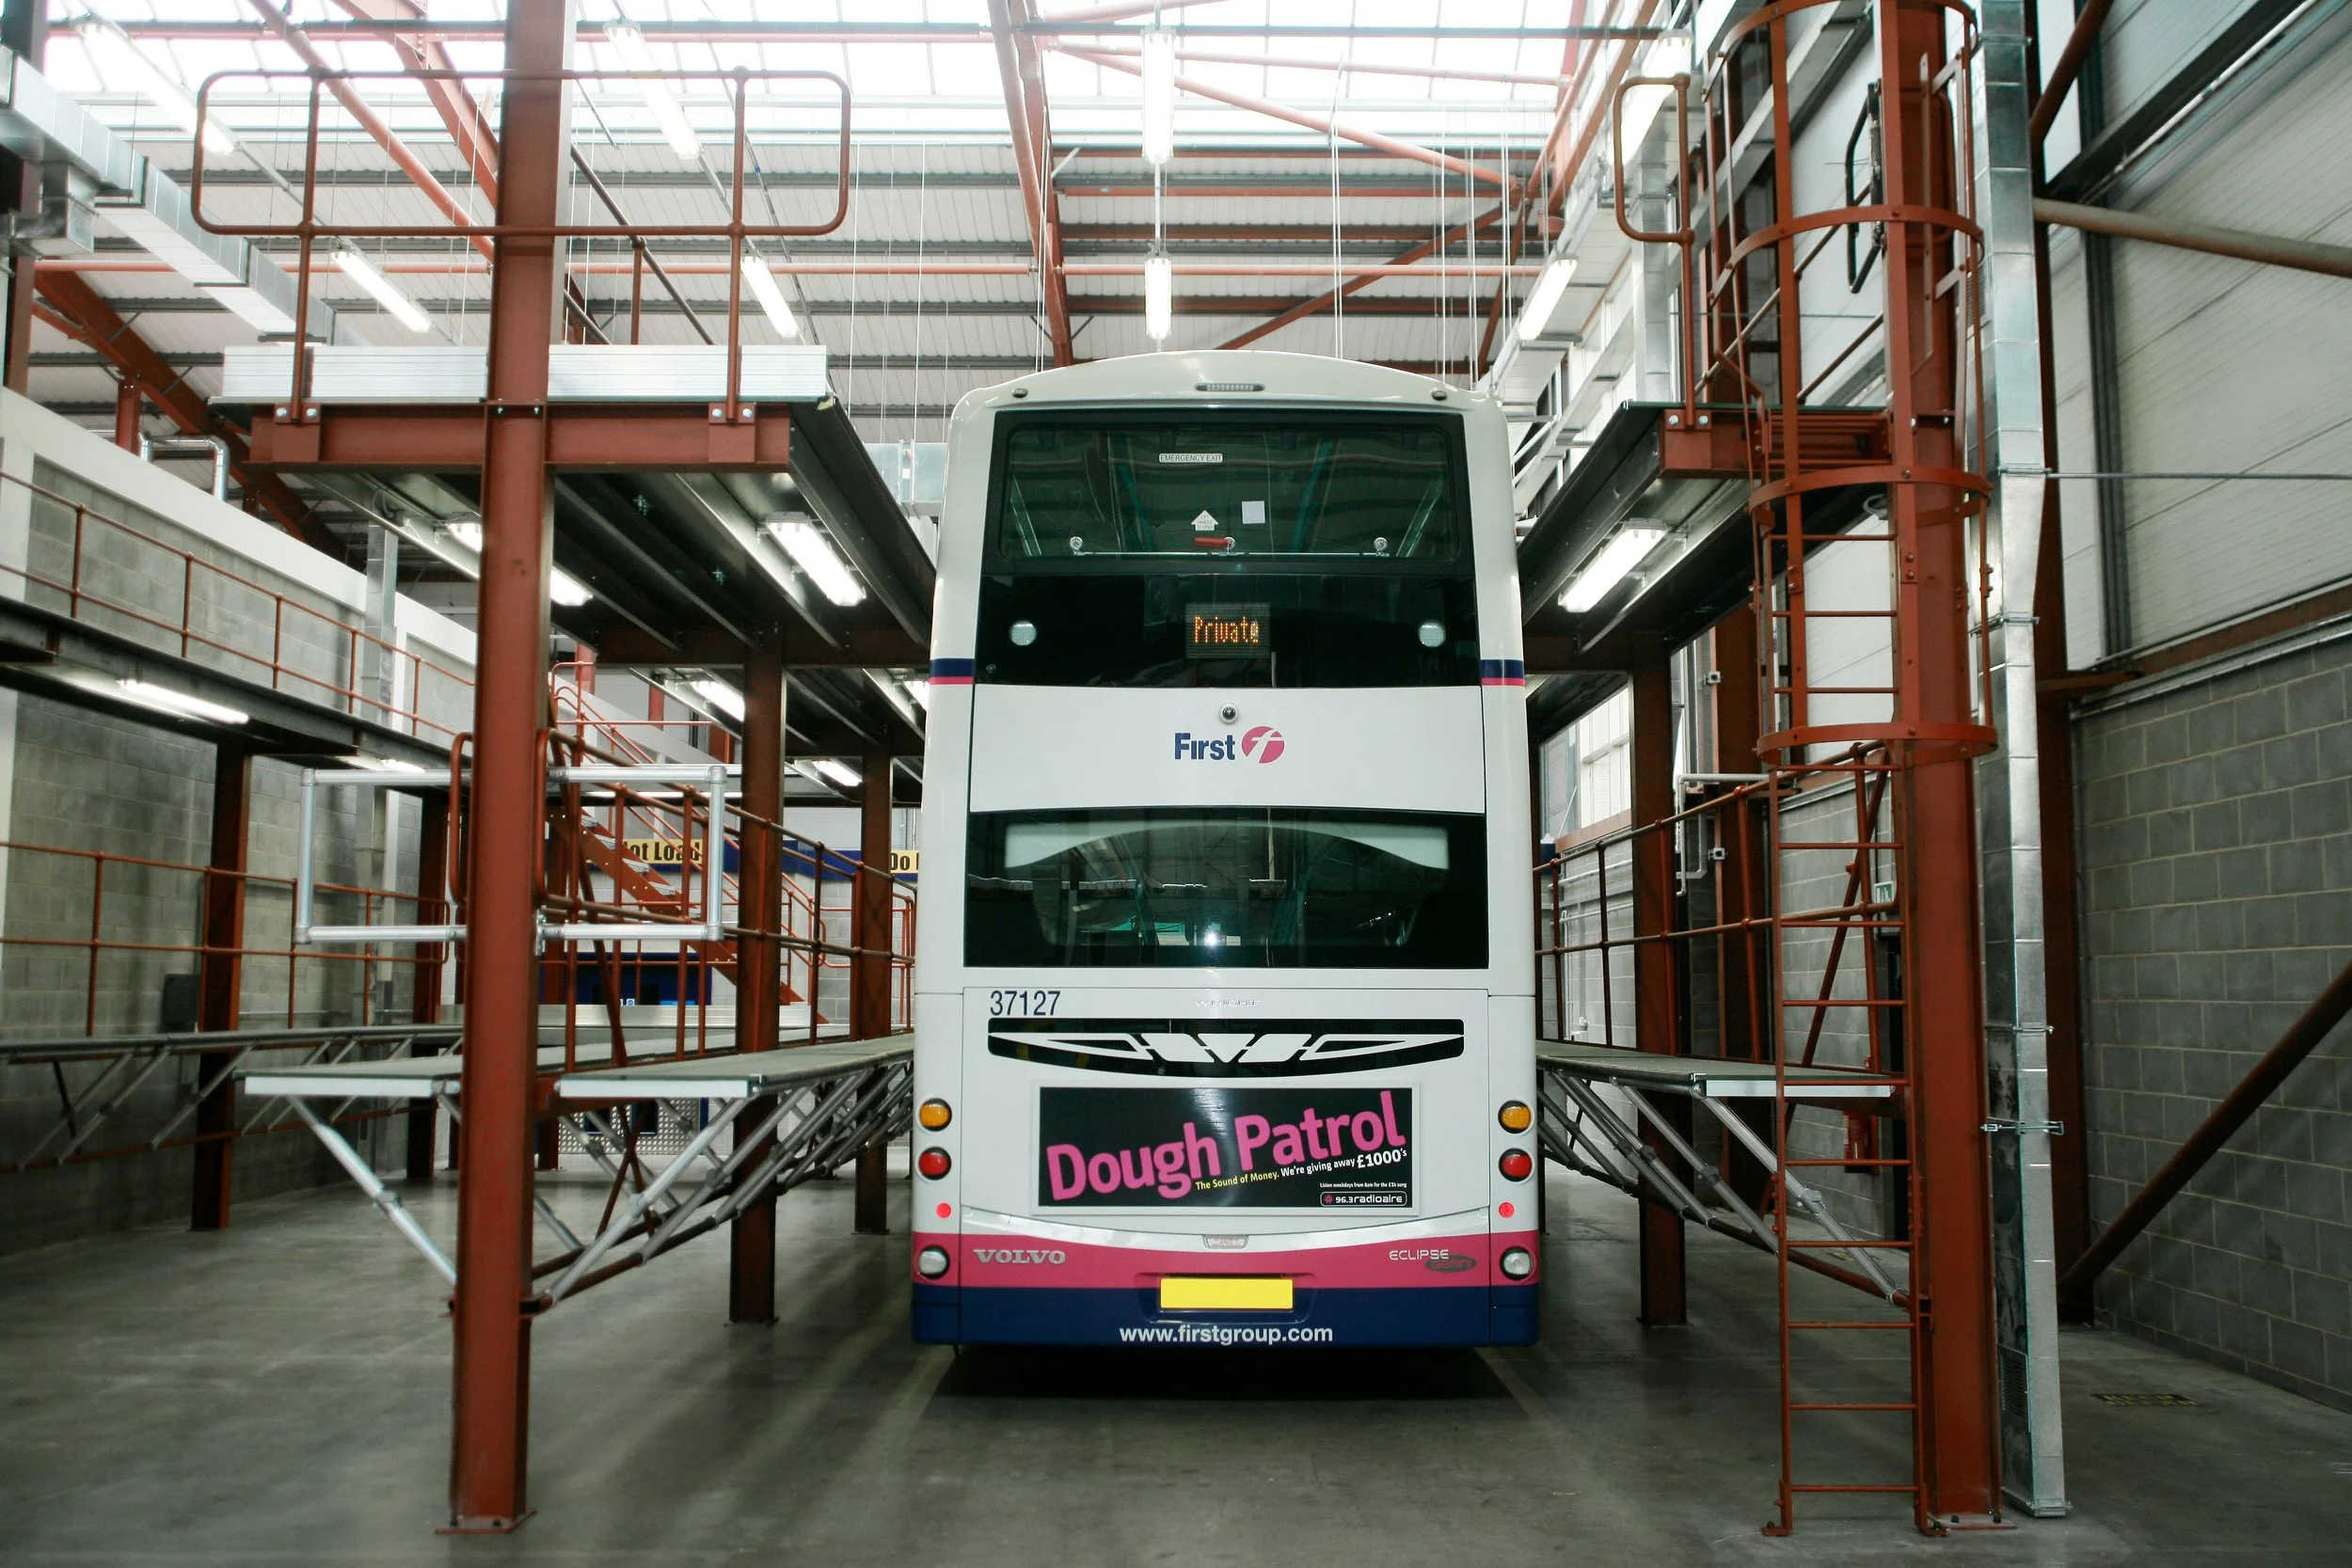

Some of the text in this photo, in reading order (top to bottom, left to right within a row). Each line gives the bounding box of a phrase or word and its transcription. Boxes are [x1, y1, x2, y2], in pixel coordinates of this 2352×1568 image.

[1194, 616, 1259, 642] Private
[1174, 732, 1235, 760] First
[624, 841, 648, 861] ot
[989, 990, 1061, 1016] 37127
[1194, 999, 1261, 1008] WRIGHT
[1046, 1090, 1406, 1201] Dough Patrol
[1195, 1148, 1407, 1191] The Sound of Money. We're giving away £1000's
[973, 1249, 1066, 1264] VOLVO
[1389, 1249, 1449, 1260] ECLIPSE
[1119, 1324, 1333, 1346] www.firstgroup.com
